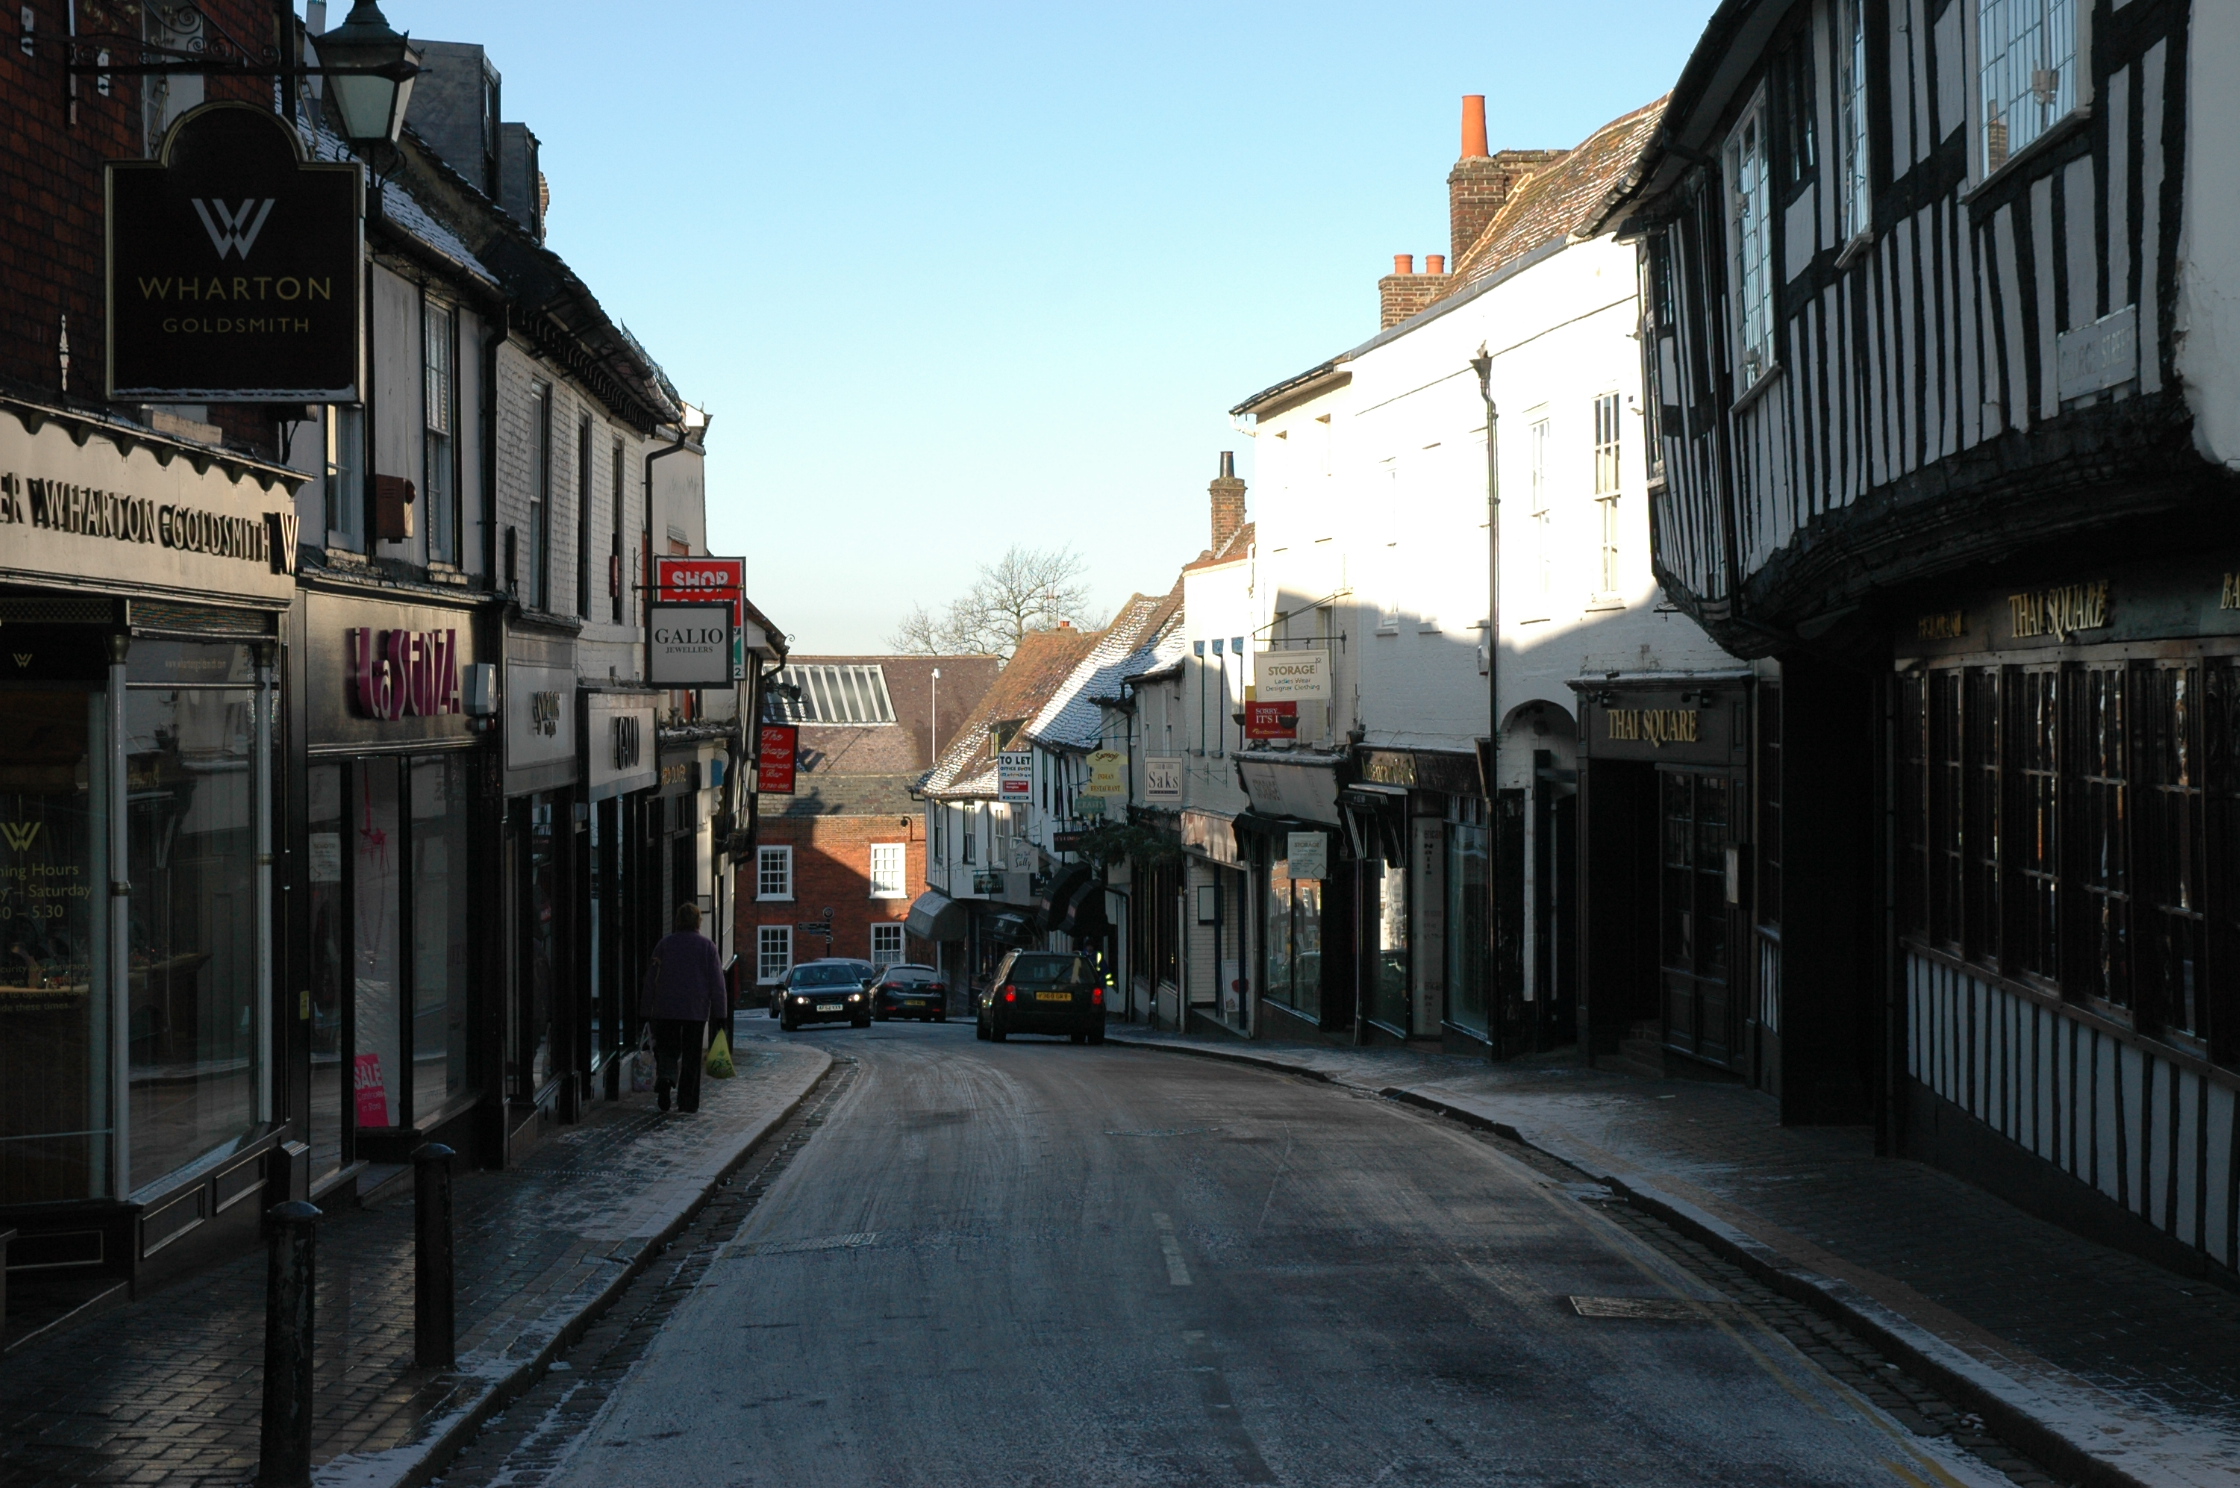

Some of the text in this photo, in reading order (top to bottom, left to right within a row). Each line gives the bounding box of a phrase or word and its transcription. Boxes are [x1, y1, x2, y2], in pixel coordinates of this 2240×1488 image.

[138, 276, 331, 300] WHARTON
[162, 317, 310, 333] GOLDSMITH
[38, 478, 157, 543] WHARTON
[168, 504, 271, 562] GOLDSMITH
[672, 570, 729, 593] SHOP
[2008, 579, 2109, 643] THAI SQUARE
[654, 627, 724, 645] GALIO
[665, 646, 714, 654] JEWELLERS
[1268, 664, 1315, 676] STORAGE
[1607, 708, 1697, 748] THAI SQUARE
[1000, 756, 1031, 764] TO LET
[1148, 771, 1179, 788] Saks
[32, 863, 80, 877] Hours
[28, 882, 92, 900] Saturday
[32, 904, 64, 919] 5.30
[354, 1063, 383, 1090] SALE
